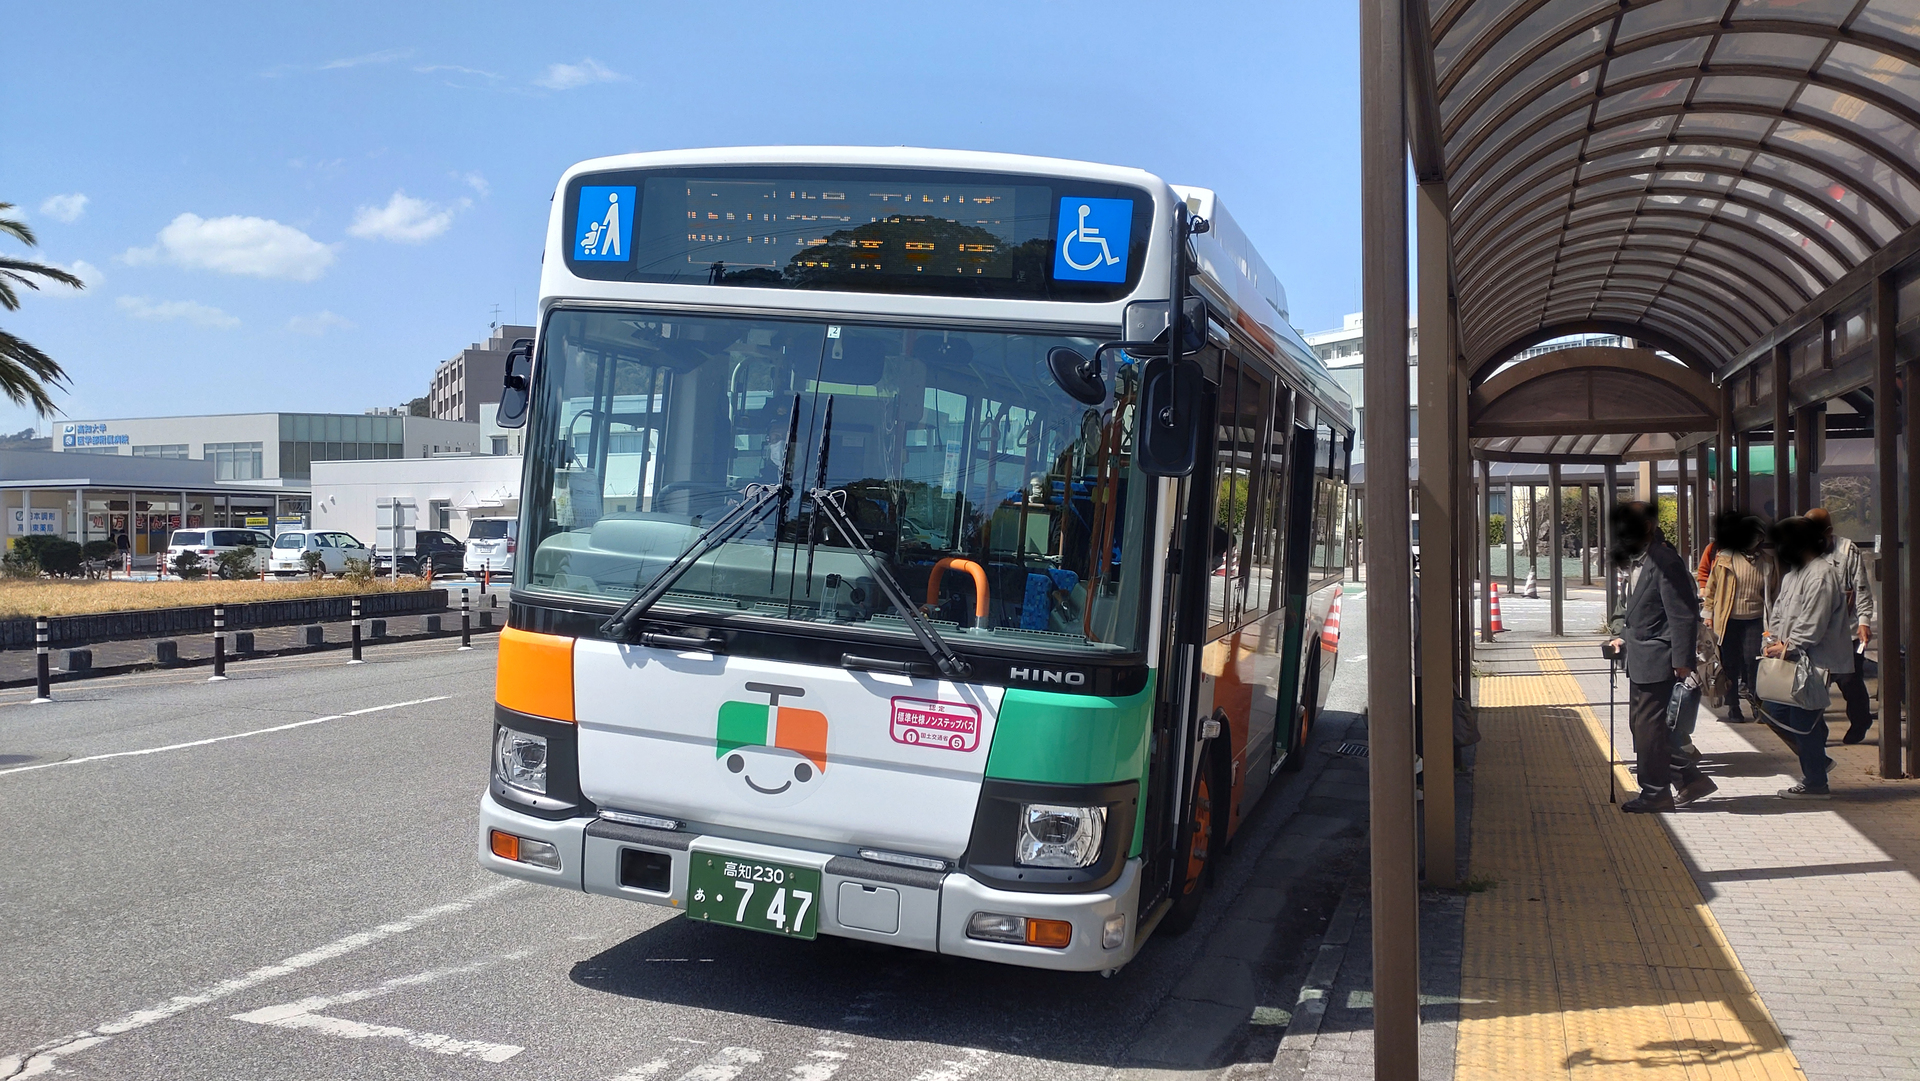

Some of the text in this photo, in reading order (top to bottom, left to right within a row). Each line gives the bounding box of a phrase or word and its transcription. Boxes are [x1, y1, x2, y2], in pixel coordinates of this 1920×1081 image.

[77, 424, 107, 435] 高知大学
[17, 523, 54, 532] 高東薬局
[1010, 667, 1085, 686] HINO
[897, 711, 974, 732] 標準仕様ノンステップバス
[920, 732, 949, 742] 国土交通省
